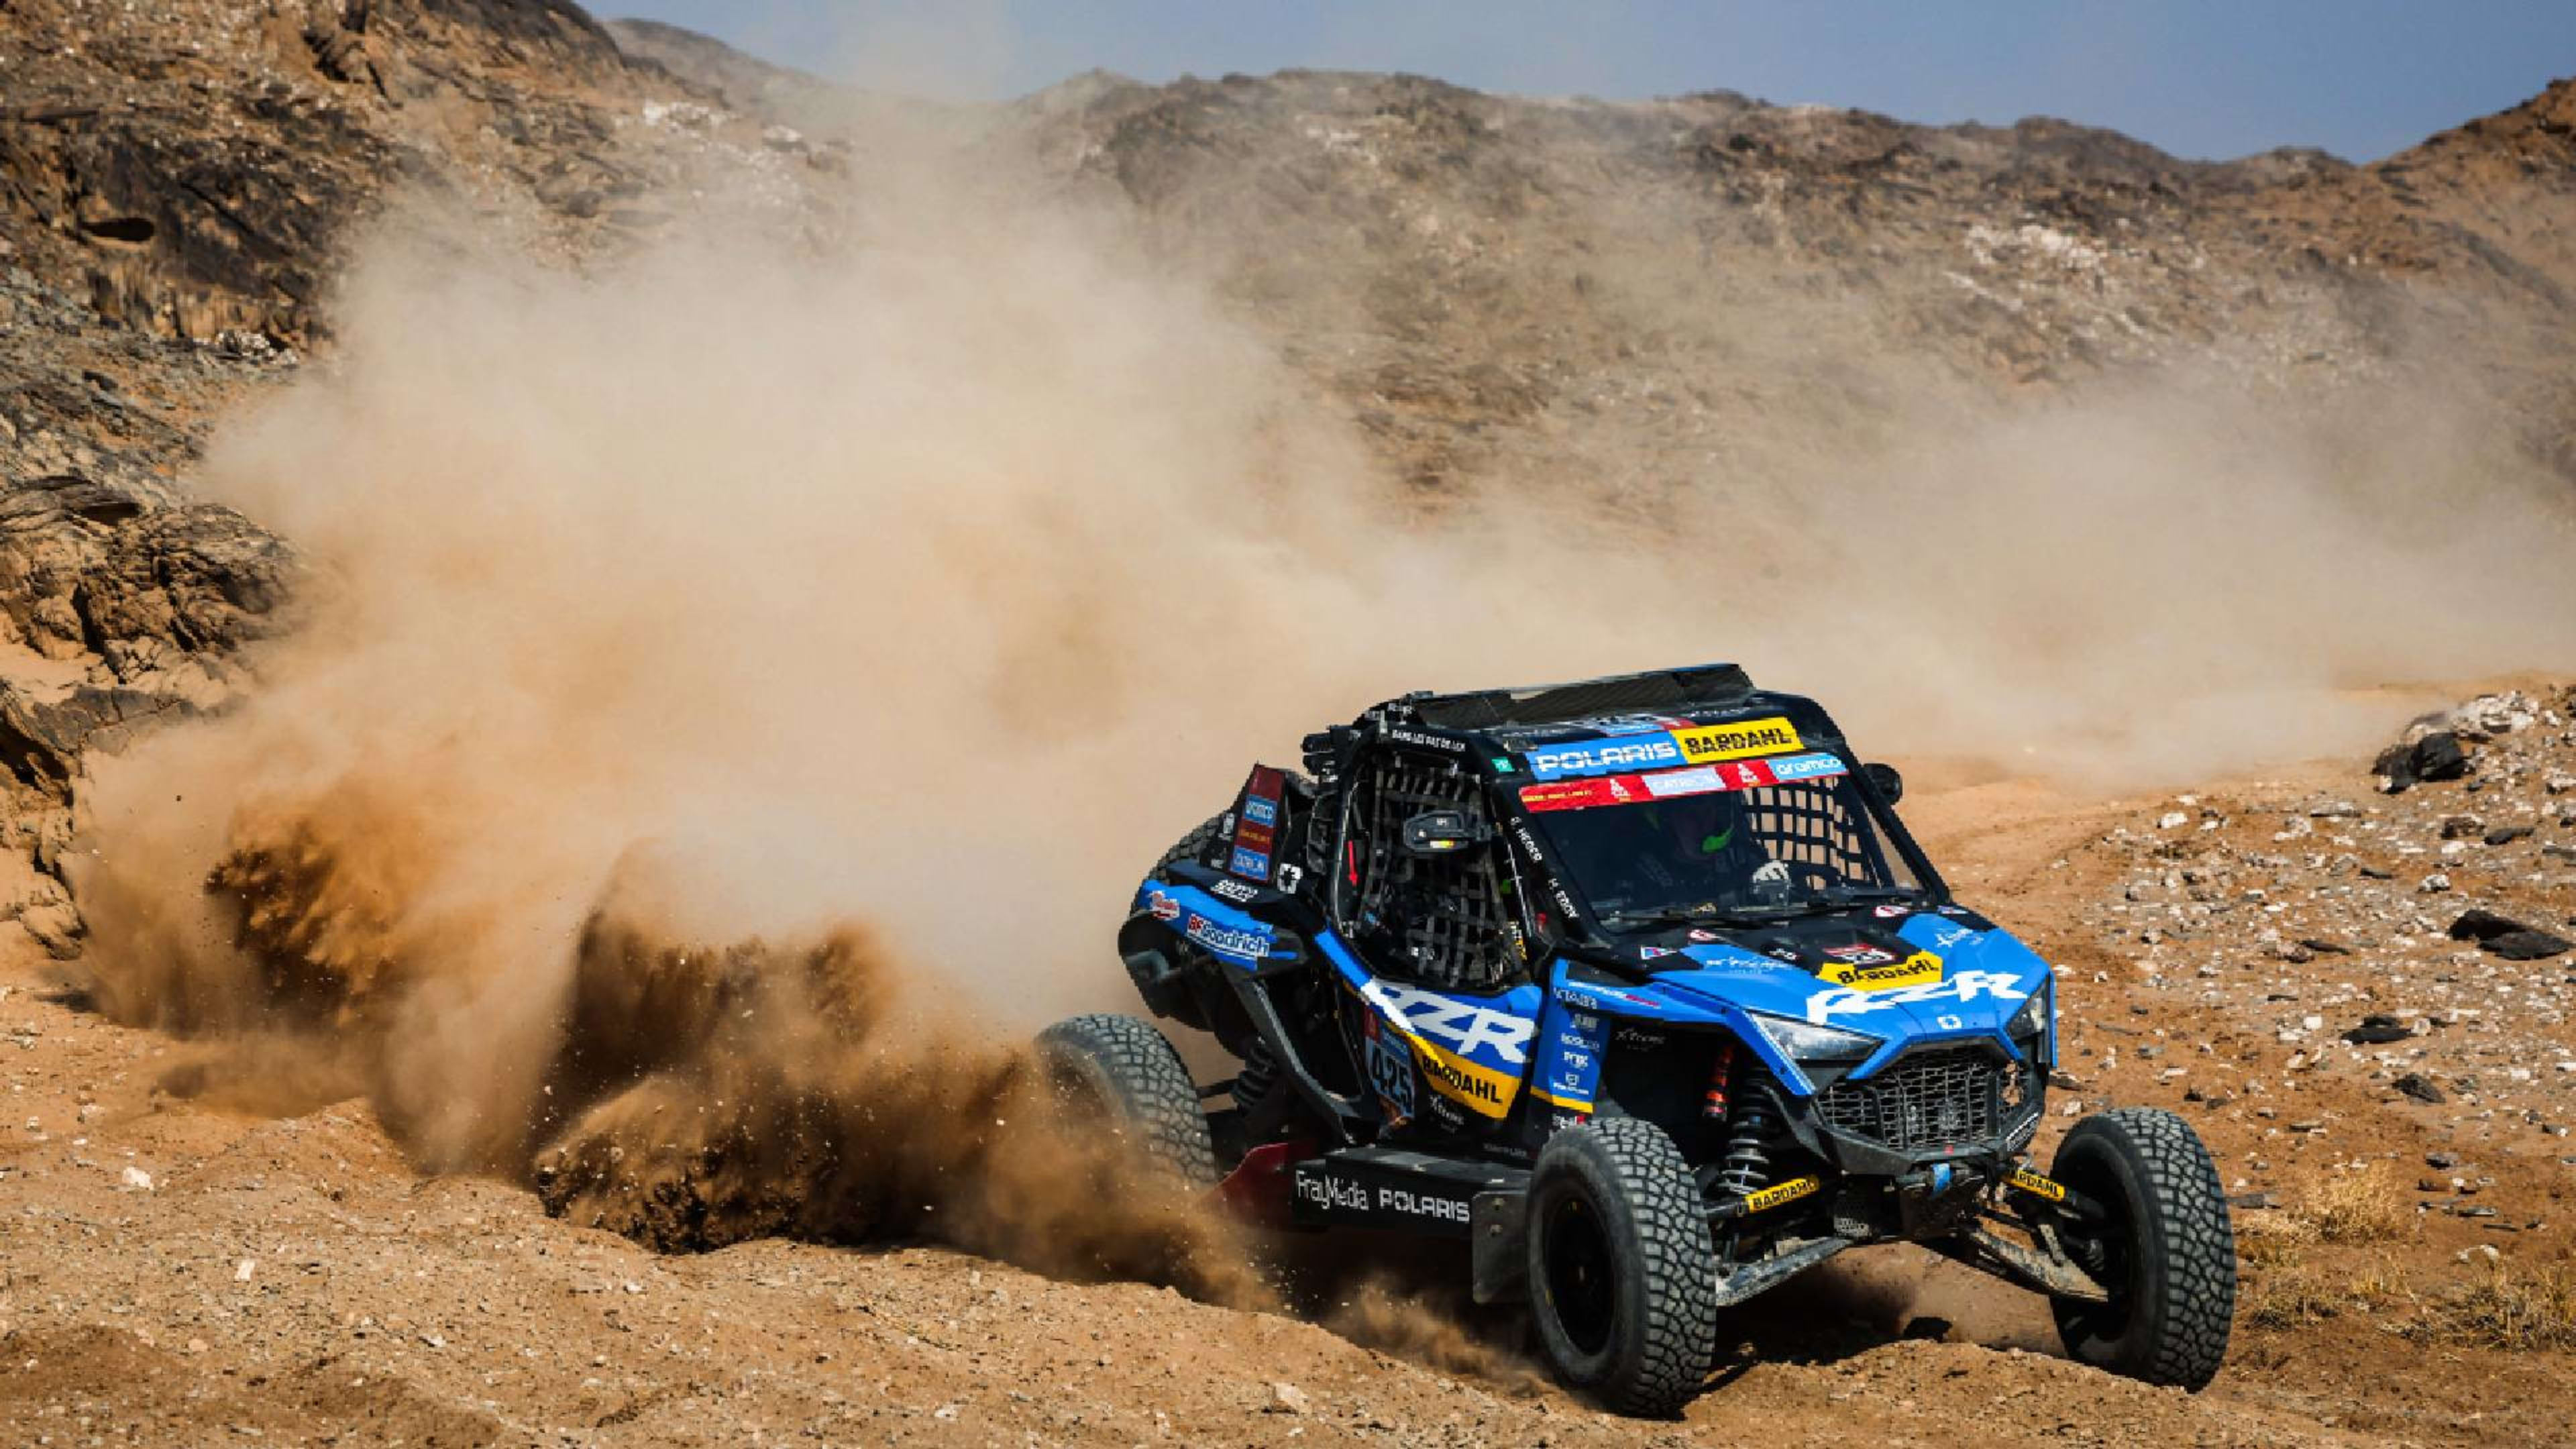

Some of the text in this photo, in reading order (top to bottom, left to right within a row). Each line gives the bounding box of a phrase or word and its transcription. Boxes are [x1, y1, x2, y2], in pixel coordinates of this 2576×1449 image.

[1536, 742, 1677, 771] POLARIS
[1684, 728, 1792, 756] BARDAHL
[1776, 757, 1842, 775] aramco
[1187, 913, 1269, 958] BFGoodrich
[1837, 958, 1939, 985] BARDAHL
[1806, 970, 2029, 1025] RZR
[1360, 975, 1536, 1063] RZR
[1369, 1042, 1413, 1118] 425
[1421, 1053, 1503, 1104] BARDAHL
[1379, 1186, 1470, 1224] POLARIS
[1752, 1181, 1815, 1210] BARDAHL
